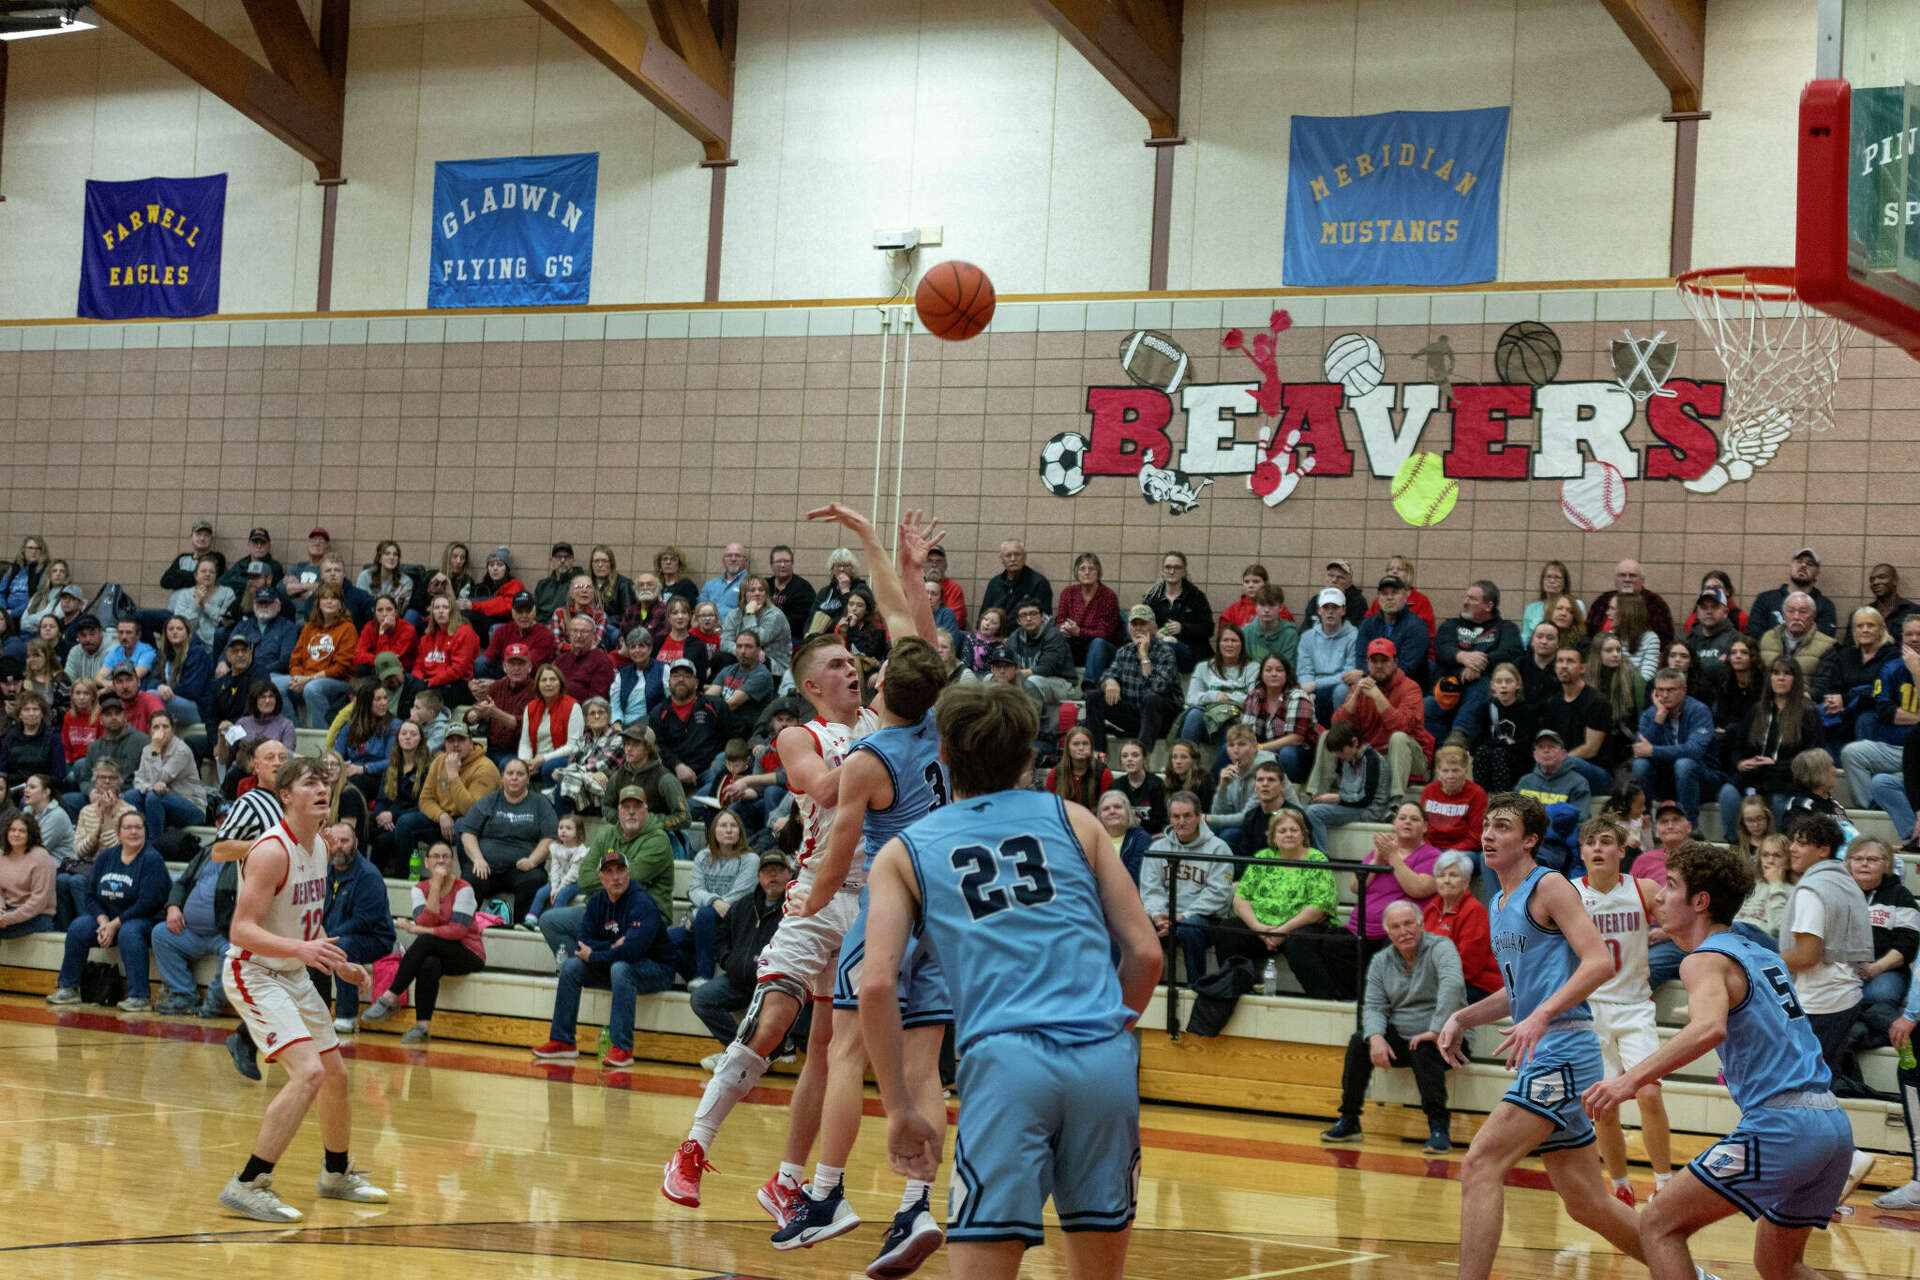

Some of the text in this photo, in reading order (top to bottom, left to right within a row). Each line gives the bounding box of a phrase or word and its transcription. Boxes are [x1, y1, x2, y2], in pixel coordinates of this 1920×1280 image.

[1309, 143, 1477, 201] MERIDIAN
[102, 204, 200, 251] FARWELL
[442, 183, 583, 239] GLADWIN
[1320, 219, 1460, 244] MUSTANGS
[109, 264, 189, 286] EAGLES
[443, 254, 574, 281] FLYING G'S
[1083, 380, 1726, 481] BEAVERS
[950, 832, 1056, 919] 23
[301, 907, 323, 942] 12
[1760, 965, 1805, 1021] 5
